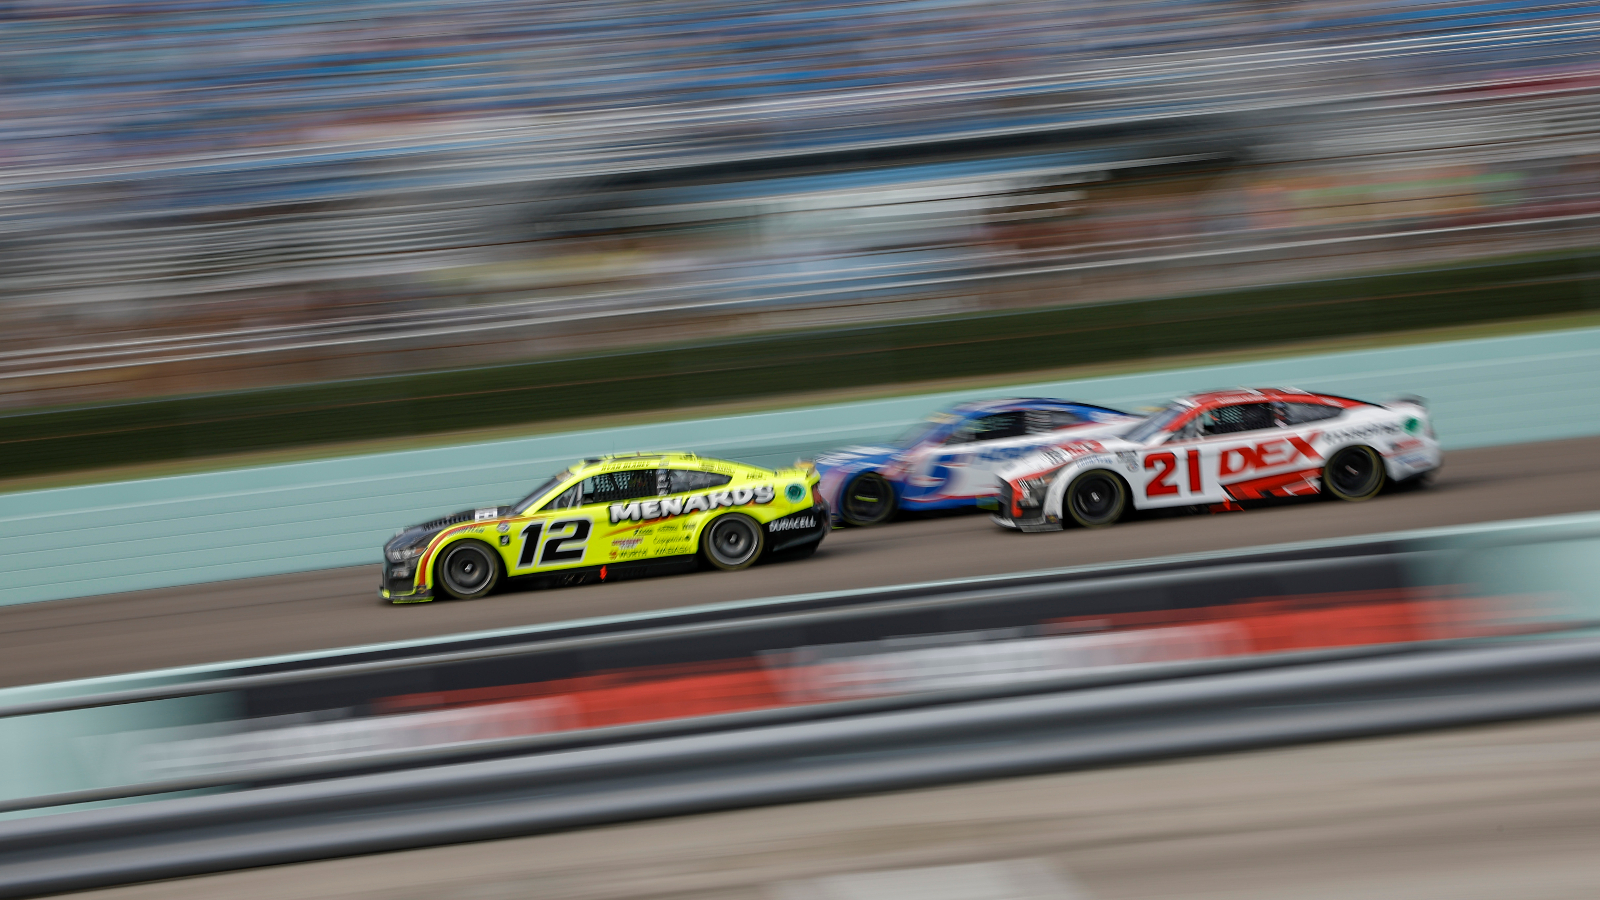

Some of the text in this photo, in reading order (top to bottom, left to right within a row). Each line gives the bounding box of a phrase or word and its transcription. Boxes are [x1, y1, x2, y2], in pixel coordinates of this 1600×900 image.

[1144, 449, 1203, 497] 21
[1218, 431, 1324, 478] DEX
[608, 485, 776, 523] MENARDS
[769, 515, 816, 532] DURACELL
[516, 517, 593, 569] 12
